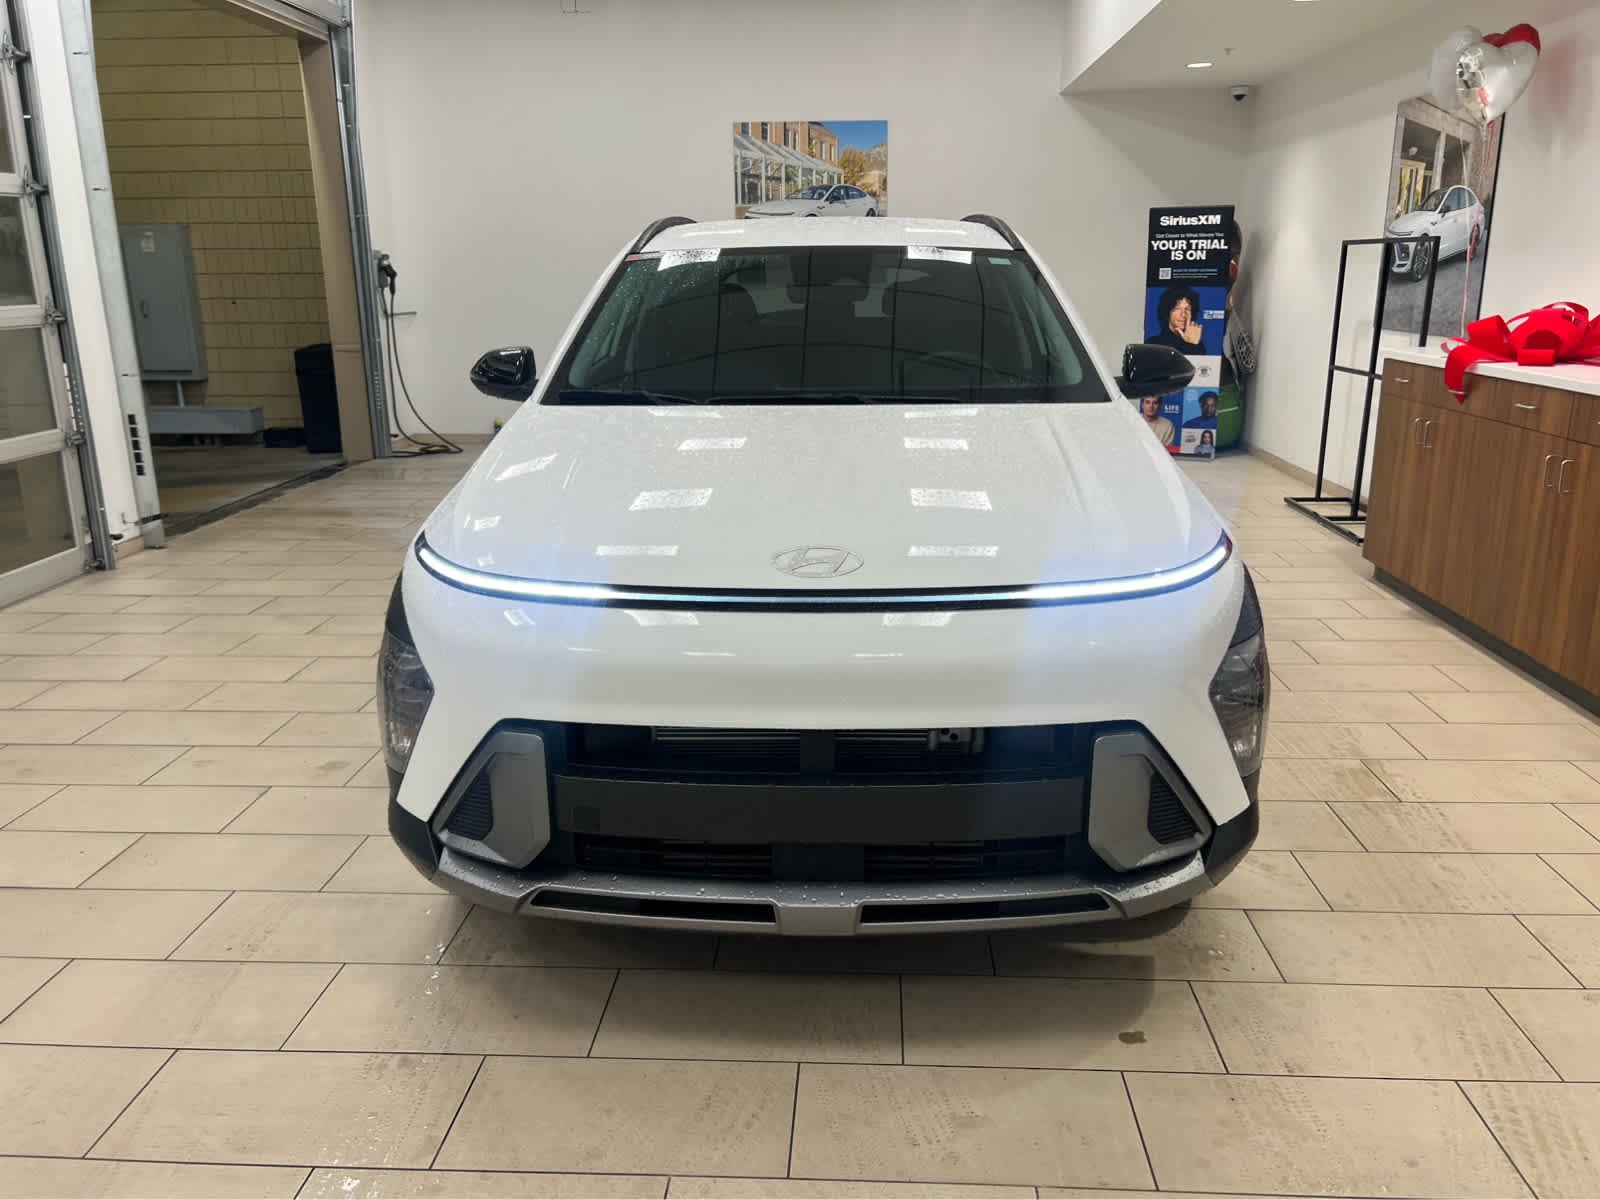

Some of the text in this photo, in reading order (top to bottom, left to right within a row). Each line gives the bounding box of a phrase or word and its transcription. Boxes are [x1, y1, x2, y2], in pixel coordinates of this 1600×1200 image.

[1160, 215, 1221, 226] SiriusXM
[1151, 239, 1228, 250] YOUR TRIAL
[1171, 250, 1207, 260] IS ON
